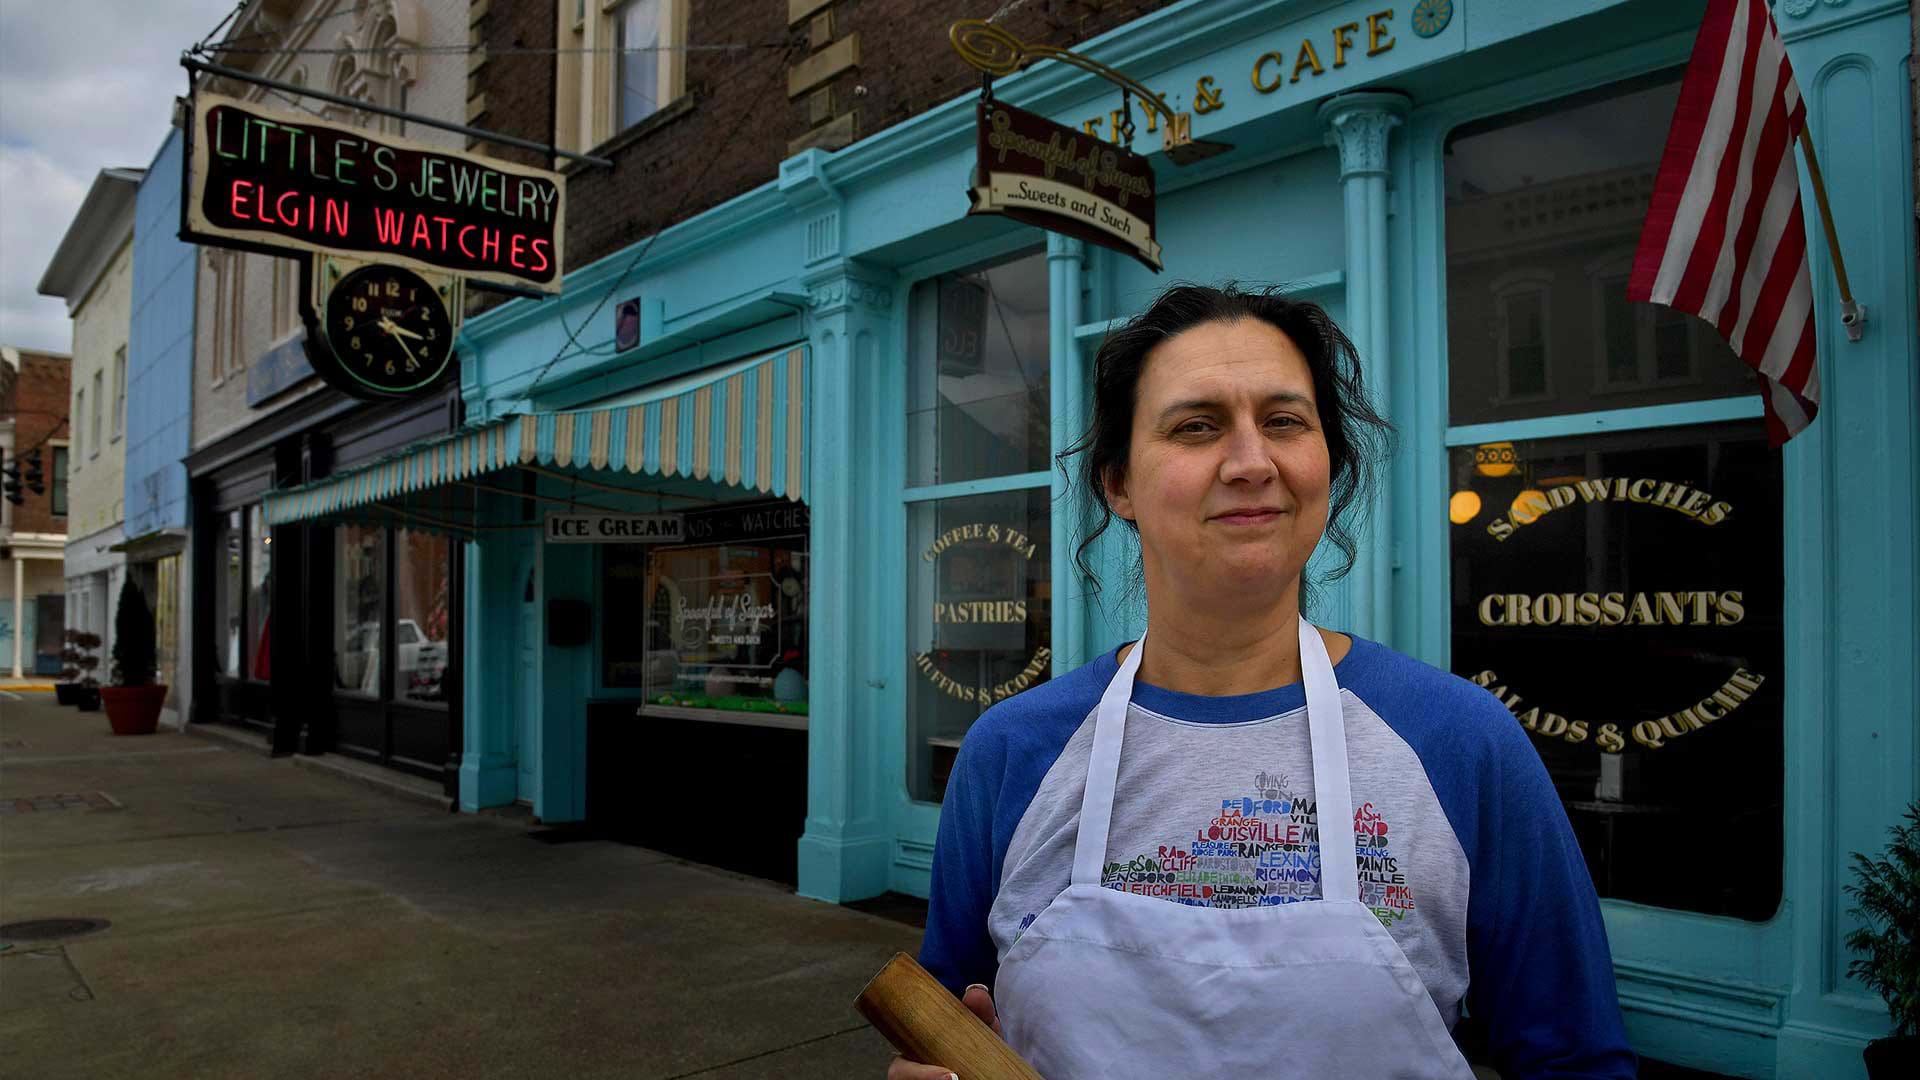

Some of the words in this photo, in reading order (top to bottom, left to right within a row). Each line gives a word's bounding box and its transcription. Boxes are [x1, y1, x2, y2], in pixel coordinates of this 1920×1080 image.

[1192, 75, 1224, 115] &
[1251, 9, 1396, 94] CAFE
[216, 111, 398, 191] LITTLE'S
[410, 156, 557, 223] JEWELRY
[988, 110, 1078, 177] Spoonful
[1076, 145, 1101, 193] of
[1099, 150, 1152, 208] Sugar
[231, 180, 349, 237] ELGIN
[375, 207, 549, 272] WATCHES
[1070, 202, 1098, 219] and
[1100, 205, 1131, 235] Such
[367, 280, 381, 297] 11
[384, 279, 401, 299] 12
[409, 288, 416, 303] 1
[351, 295, 368, 313] 10
[420, 305, 431, 321] 2
[343, 315, 355, 332] 9
[426, 327, 437, 341] 3
[350, 335, 361, 351] 8
[418, 344, 430, 359] 4
[363, 352, 375, 369] 7
[384, 359, 396, 376] 6
[1487, 476, 1734, 543] SANDWICHES
[552, 518, 590, 537] ICE
[599, 517, 678, 537] CREAM
[923, 523, 984, 562] COFFEE
[986, 524, 1000, 543] &
[1005, 527, 1037, 560] TEA
[739, 593, 776, 633] Sugar
[933, 600, 1027, 624] PASTRIES
[1478, 590, 1745, 626] CROISSANTS
[916, 651, 975, 701] MUFFINS
[978, 687, 992, 706] &
[994, 646, 1051, 700] SCONES
[1471, 669, 1589, 744] SALADS
[1595, 722, 1625, 753] &
[1632, 667, 1766, 750] QUICHE
[1254, 771, 1289, 789] COVING
[1259, 788, 1294, 801] TON
[1222, 797, 1291, 817] BEDFORD
[1222, 809, 1242, 818] LA
[1354, 802, 1382, 821] ASH
[1211, 817, 1260, 828] GRANGE
[1198, 822, 1300, 844] LOUISVILLE
[1158, 845, 1186, 859] RAD
[1192, 841, 1230, 850] PLEASURE
[1217, 849, 1238, 857] PARK
[1230, 843, 1308, 859] FRANKFORT
[1162, 855, 1198, 871] CLIFF
[1356, 856, 1398, 873] PAINTS
[1213, 884, 1268, 896] LEBANON
[1383, 898, 1415, 910] VILLE
